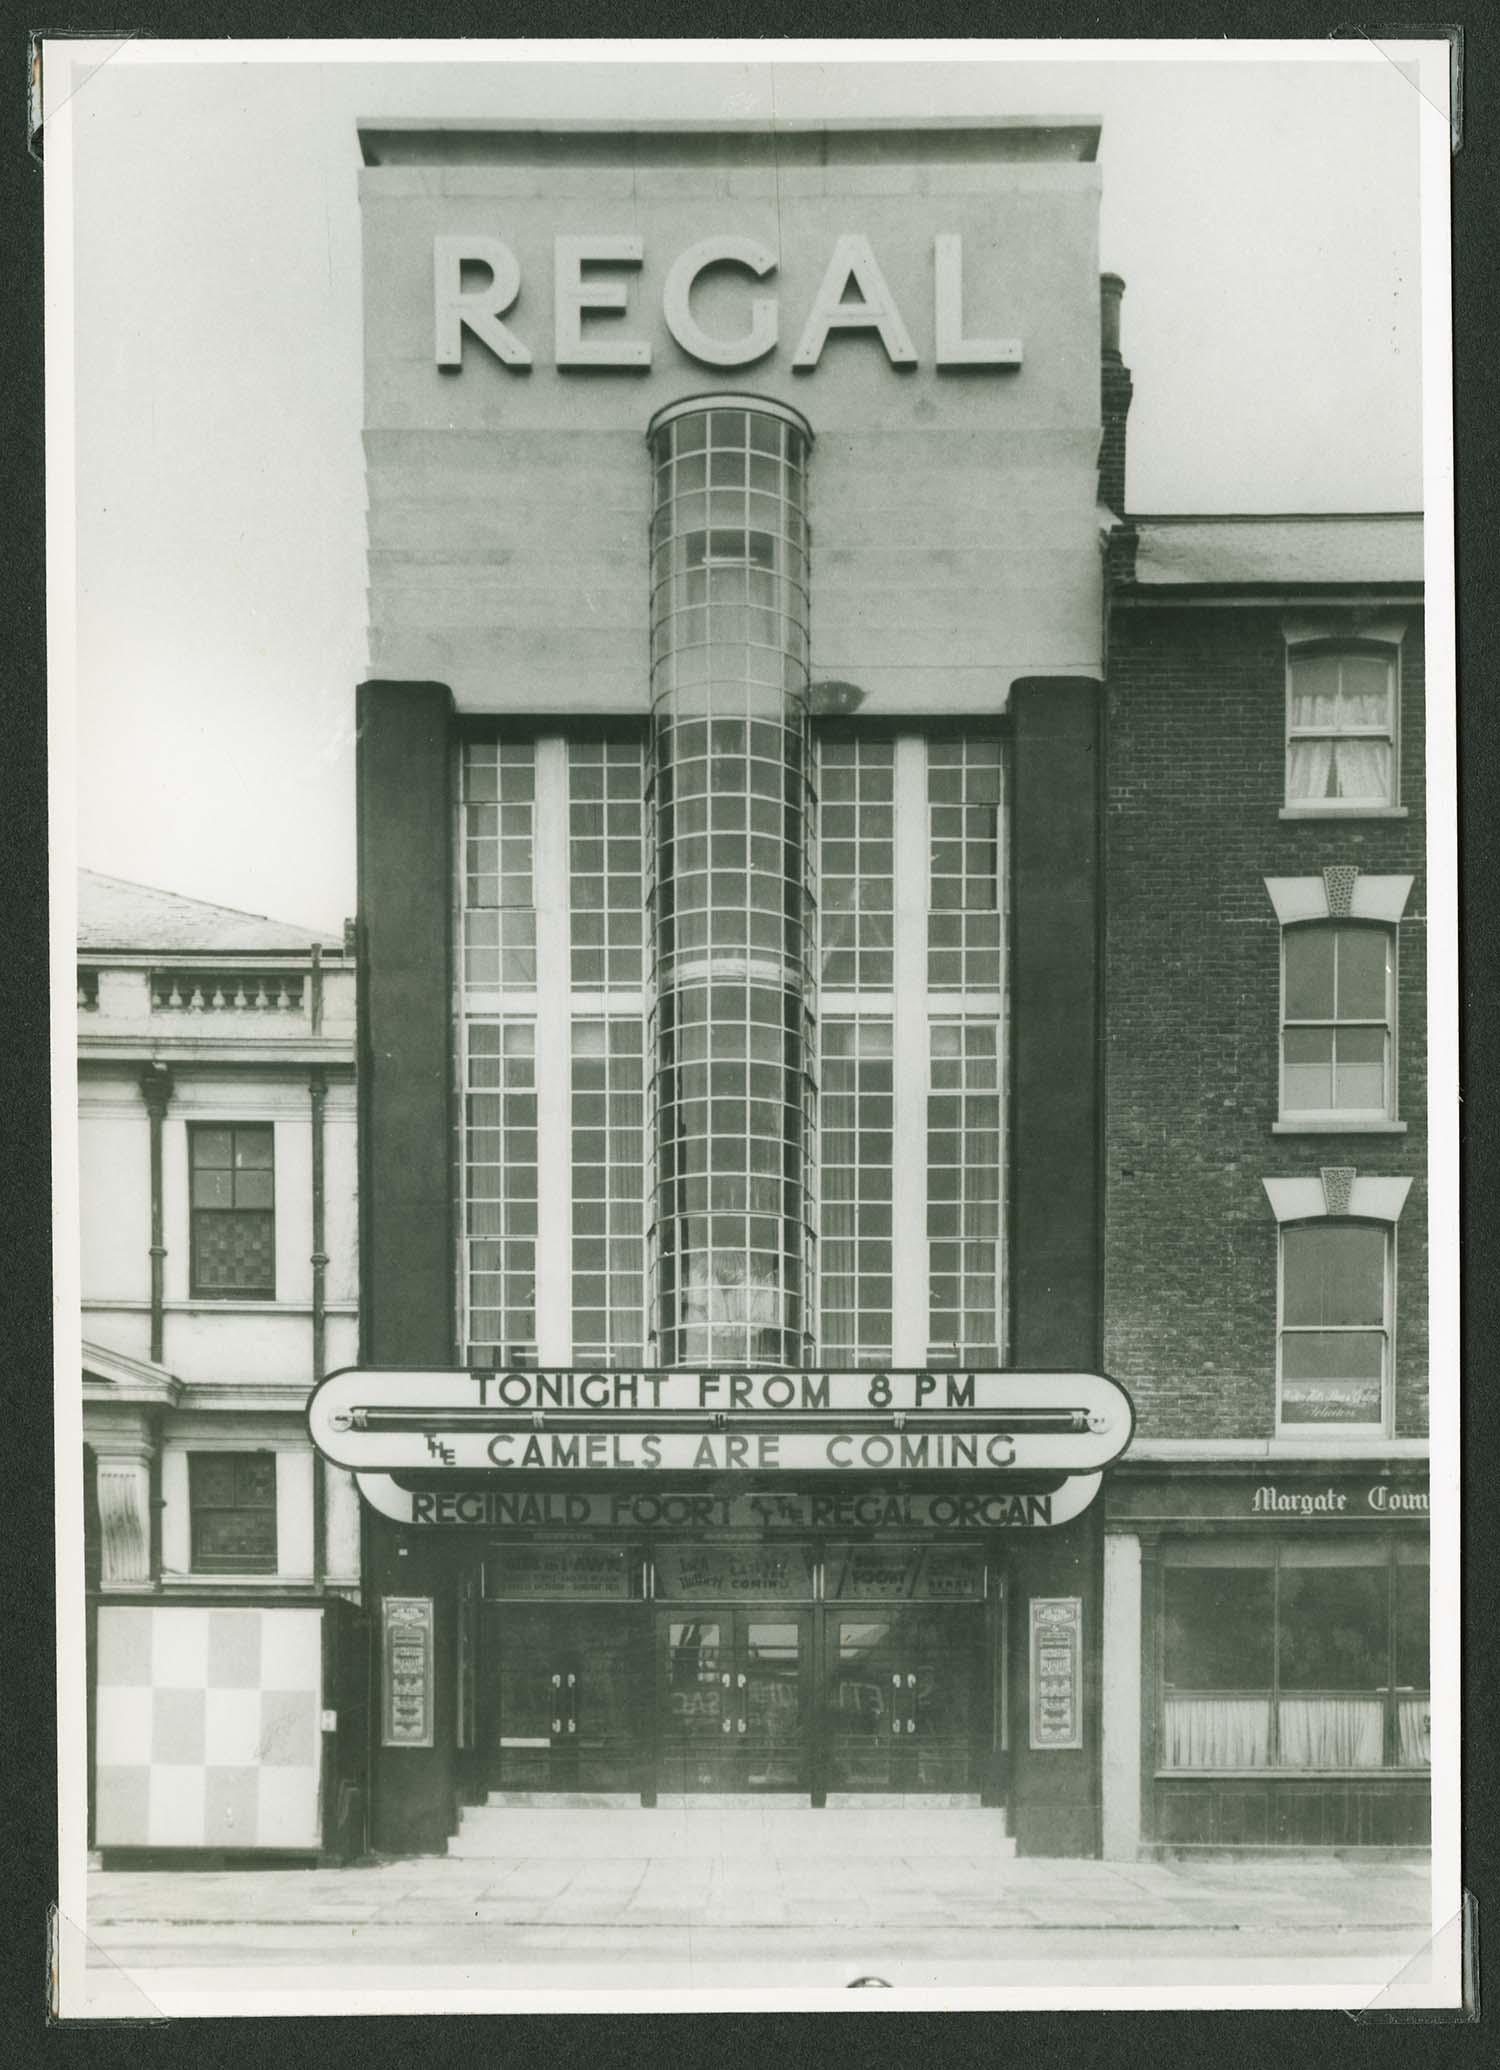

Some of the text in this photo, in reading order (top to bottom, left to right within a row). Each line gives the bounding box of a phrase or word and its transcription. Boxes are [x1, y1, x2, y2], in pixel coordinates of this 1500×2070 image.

[433, 234, 1025, 370] REGAL
[471, 1374, 977, 1408] TONIGHT FROM 8 PM
[424, 1433, 1017, 1469] THE CAMELS ARE COMING
[411, 1492, 591, 1525] REGINALD
[612, 1492, 735, 1525] FOORT
[812, 1493, 924, 1526] REGAL
[927, 1493, 1054, 1526] ORGAN
[1251, 1486, 1348, 1515] Margate
